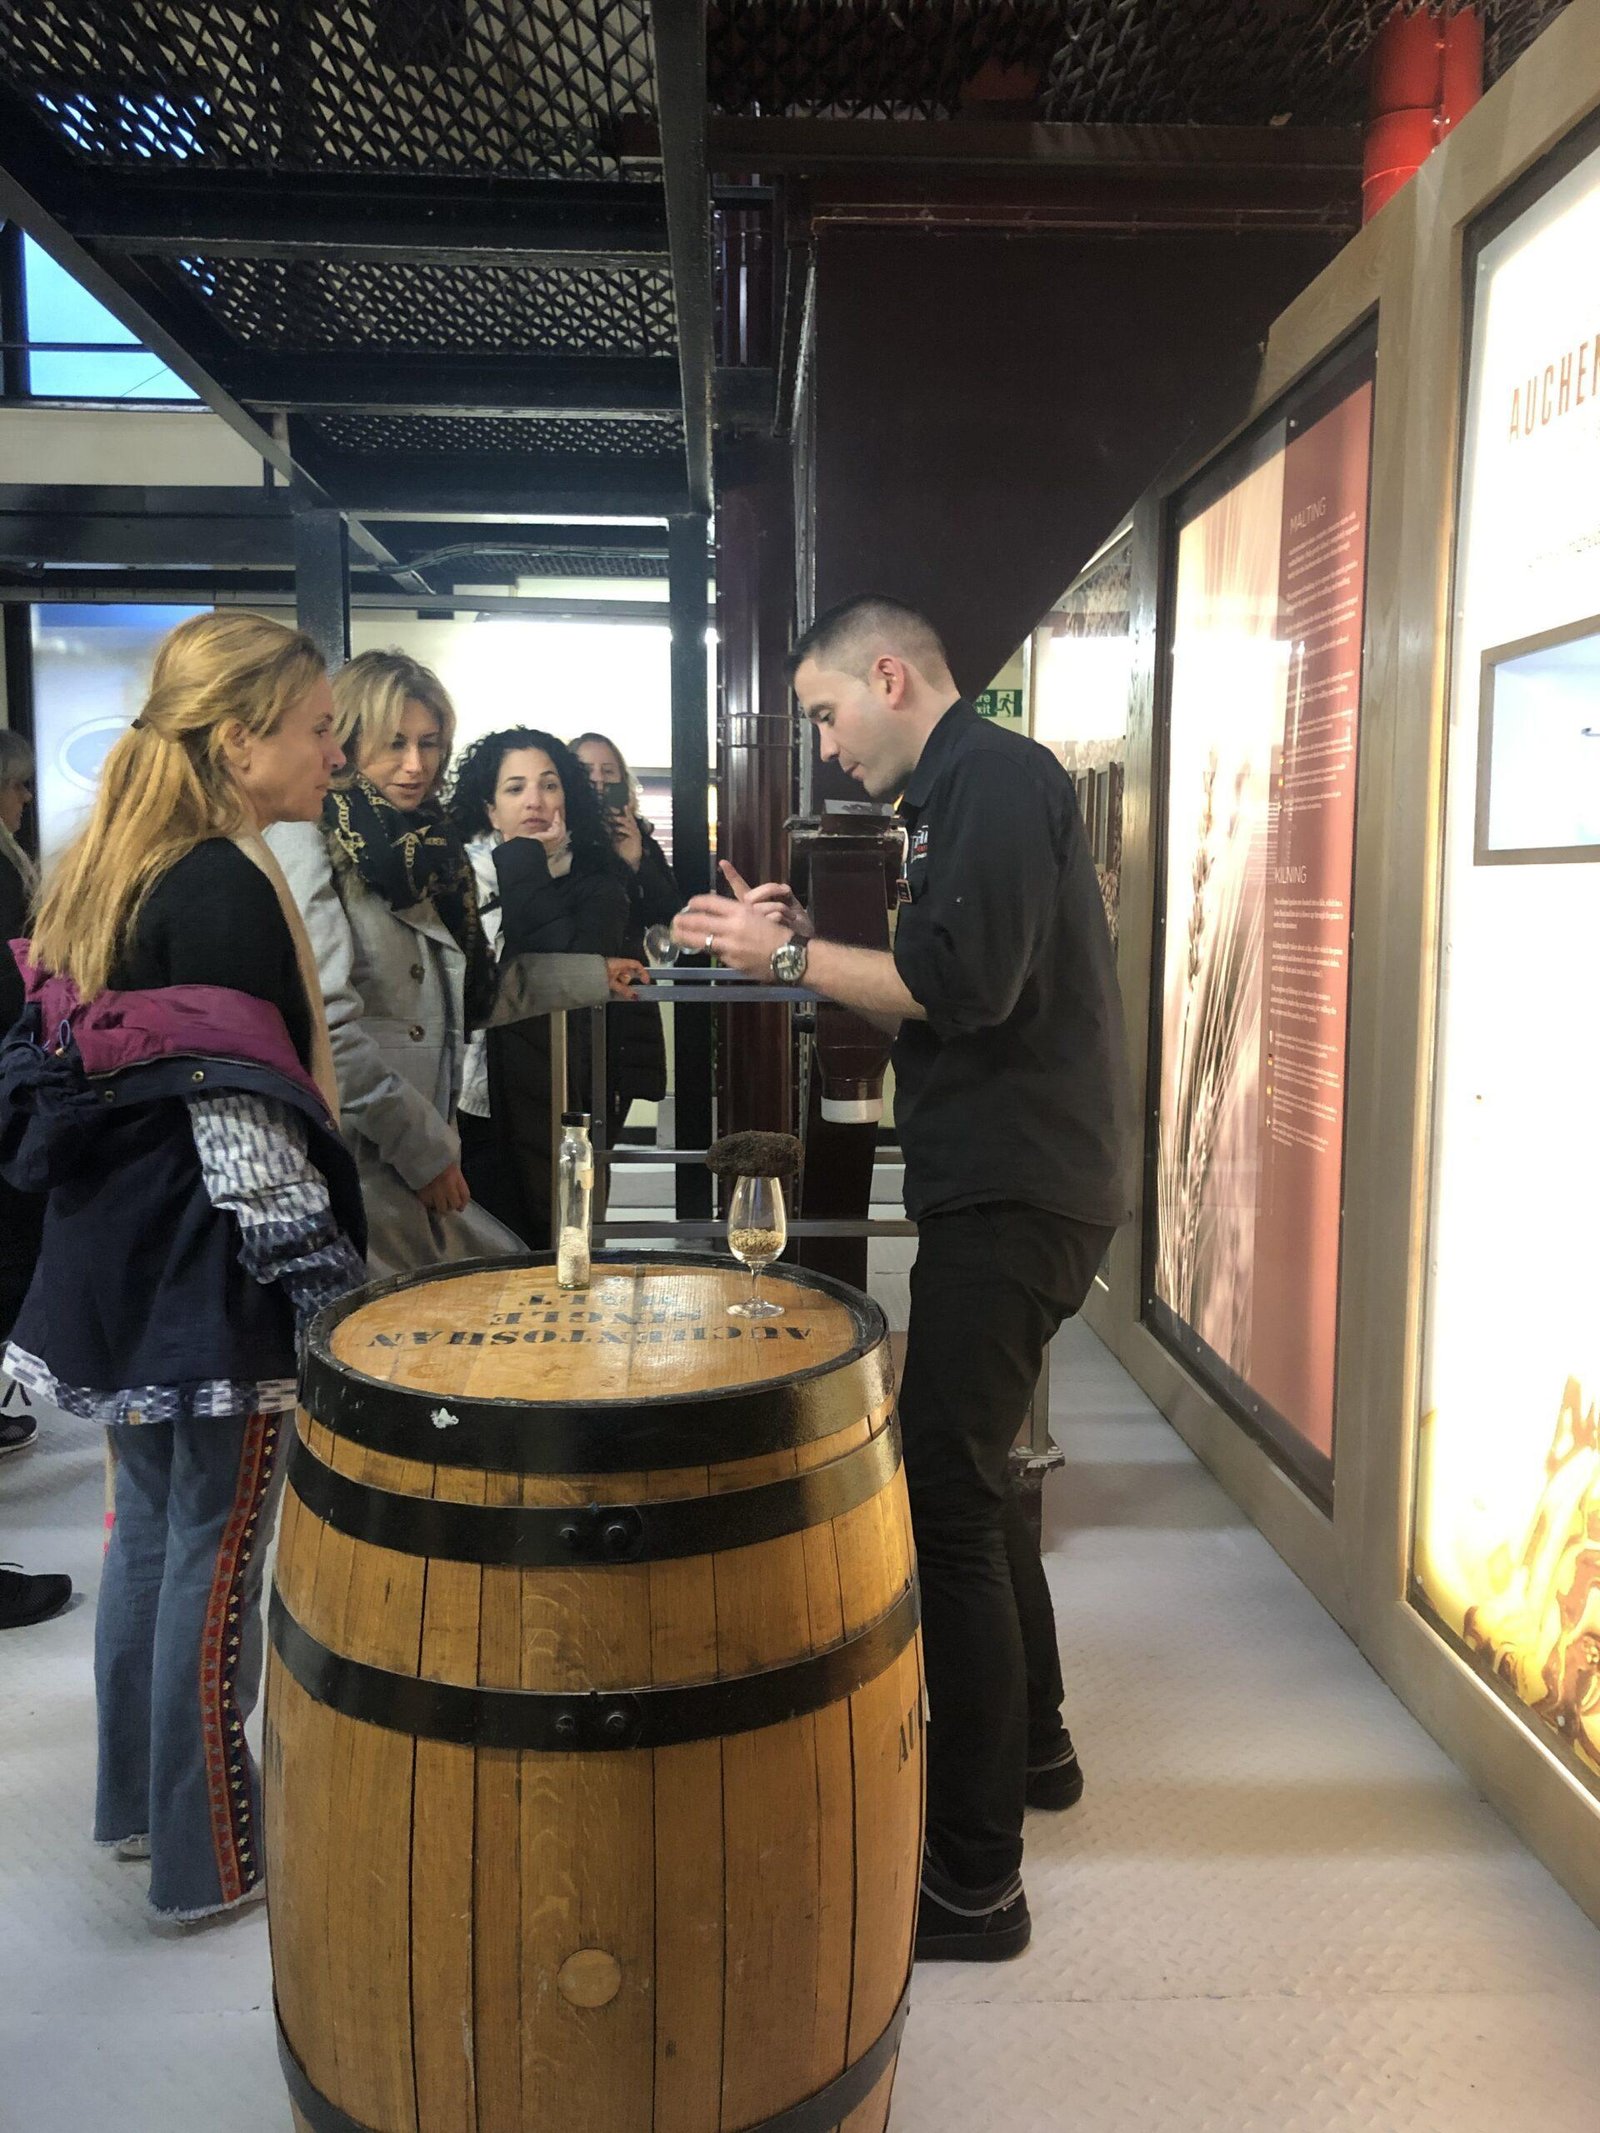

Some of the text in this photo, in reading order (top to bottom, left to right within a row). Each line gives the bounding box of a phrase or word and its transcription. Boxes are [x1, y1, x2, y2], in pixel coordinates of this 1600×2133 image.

[1289, 496, 1327, 534] MALTING
[975, 703, 991, 714] xit
[1274, 865, 1307, 884] KILNING
[490, 1310, 701, 1325] SINGLE
[367, 1327, 811, 1347] AUCHENTOSHAN
